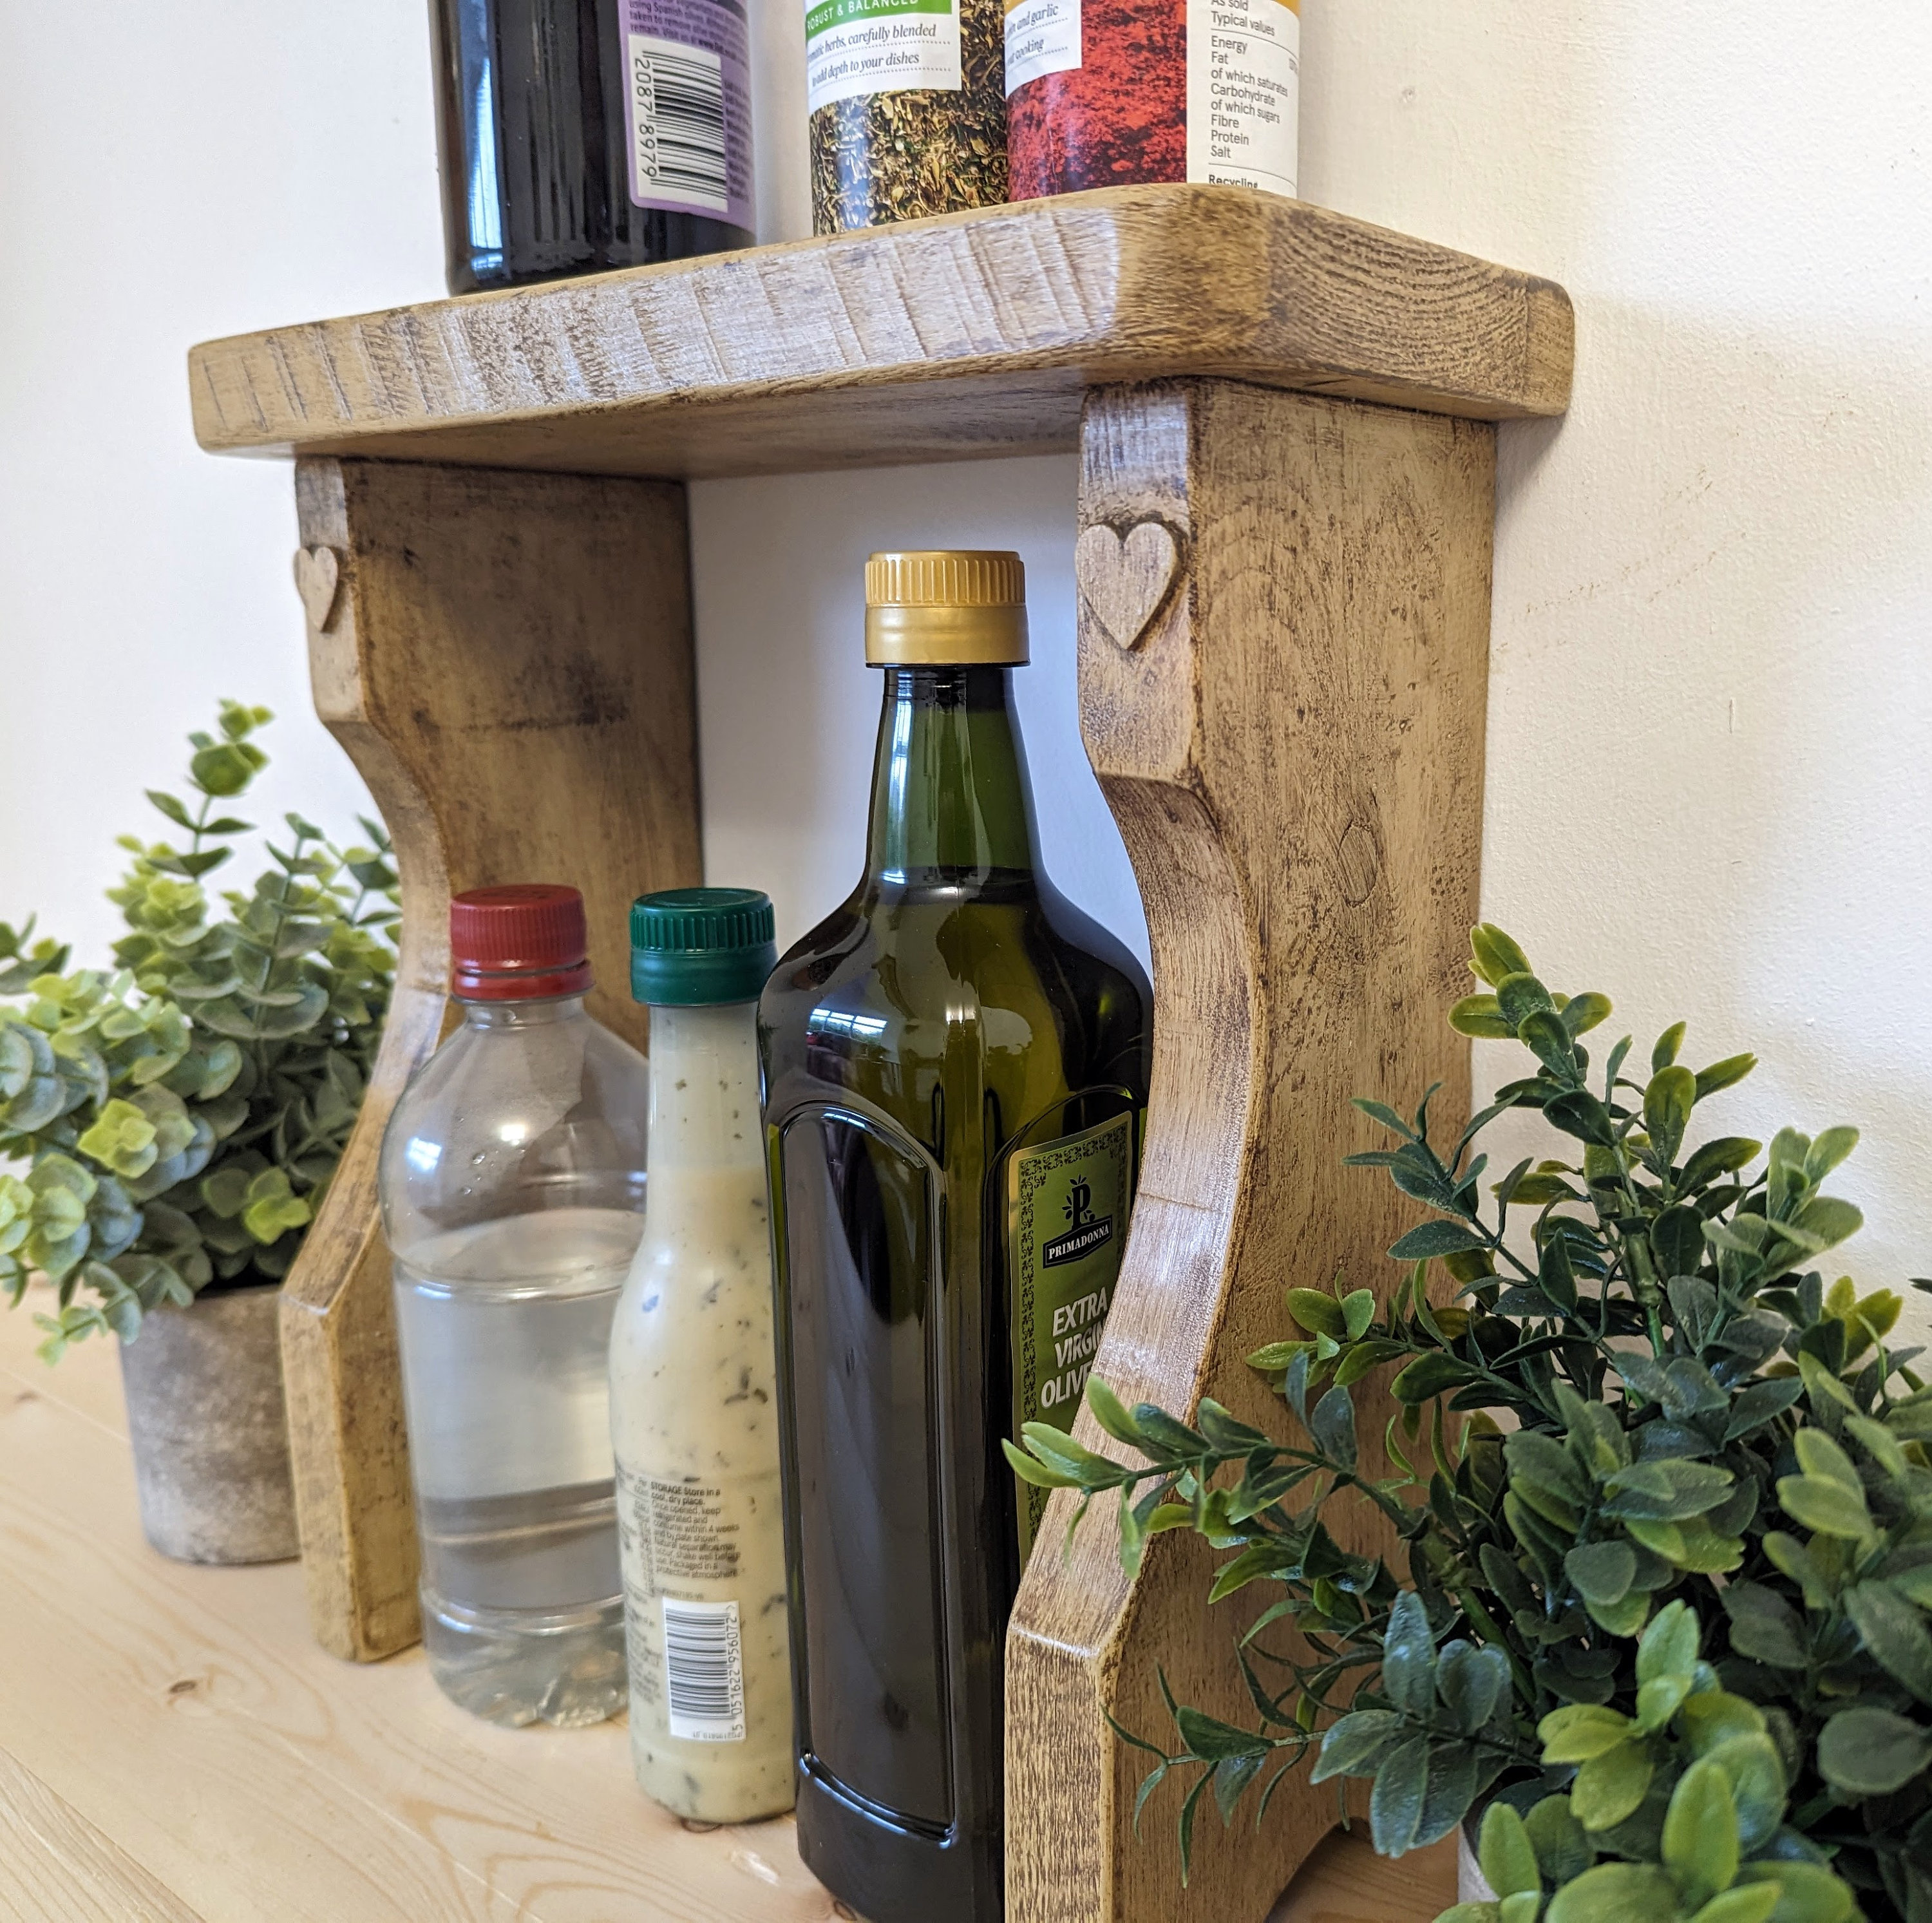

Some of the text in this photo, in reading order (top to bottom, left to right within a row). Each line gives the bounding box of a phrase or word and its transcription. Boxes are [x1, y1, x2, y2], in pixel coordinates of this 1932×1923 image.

[1031, 4, 1059, 26] garlic
[1227, 0, 1249, 11] sold
[807, 6, 833, 31] ROBUST
[838, 5, 844, 16] &
[1211, 11, 1275, 36] Typical values
[848, 26, 890, 45] carefully
[893, 23, 936, 39] blended
[1211, 35, 1248, 55] Energy
[828, 60, 848, 79] depth
[850, 60, 859, 71] to
[860, 58, 885, 73] your
[886, 52, 920, 66] dishes
[1211, 51, 1229, 65] Fat
[1211, 68, 1224, 79] of
[1225, 69, 1256, 86] which
[1211, 82, 1276, 106] Carbohydrate
[634, 57, 657, 178] 2087 8979
[1211, 99, 1280, 124] of which sugars
[1211, 113, 1240, 129] Fibre
[1211, 129, 1249, 146] Protein
[1211, 145, 1231, 159] Salt
[1048, 1224, 1110, 1260] PRIMADONNA
[1052, 1287, 1108, 1337] EXTRA
[650, 1481, 682, 1495] STORAGE
[683, 1486, 705, 1497] Store
[706, 1488, 714, 1497] in
[702, 1506, 721, 1517] keep
[715, 1524, 740, 1533] weeks
